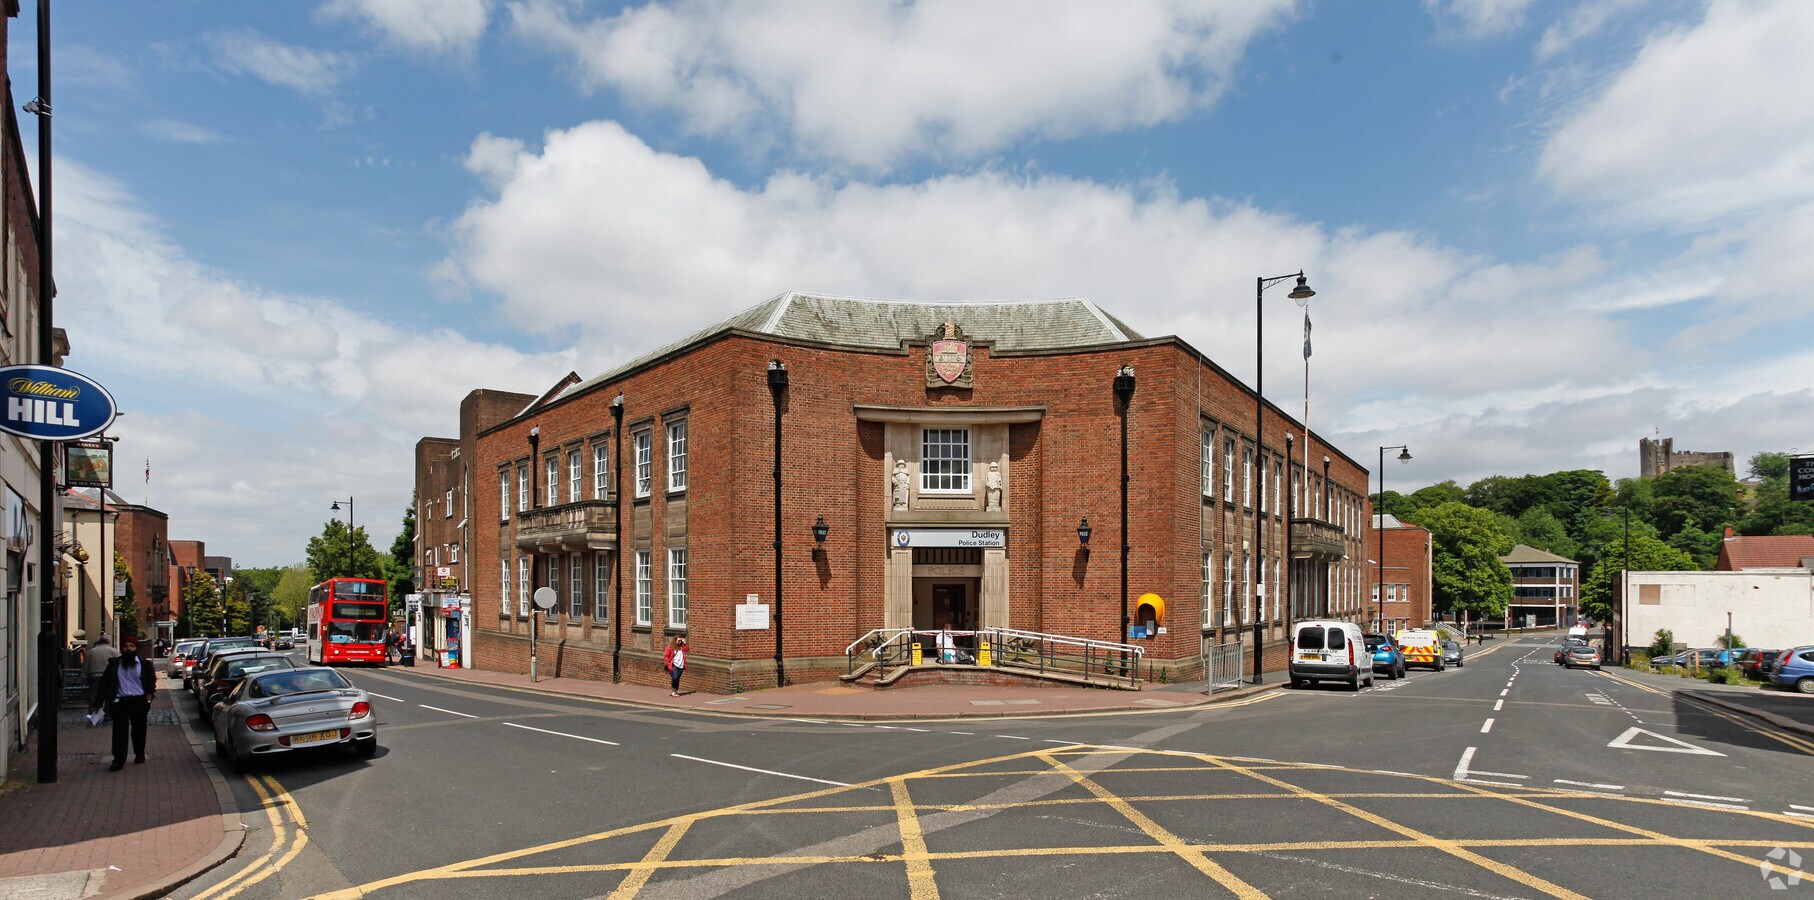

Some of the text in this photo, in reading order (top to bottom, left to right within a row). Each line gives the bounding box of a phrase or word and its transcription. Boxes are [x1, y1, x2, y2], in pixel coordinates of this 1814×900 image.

[8, 378, 80, 400] William
[8, 396, 80, 427] HILL
[971, 530, 1000, 540] Dudley
[928, 566, 965, 575] POLICE
